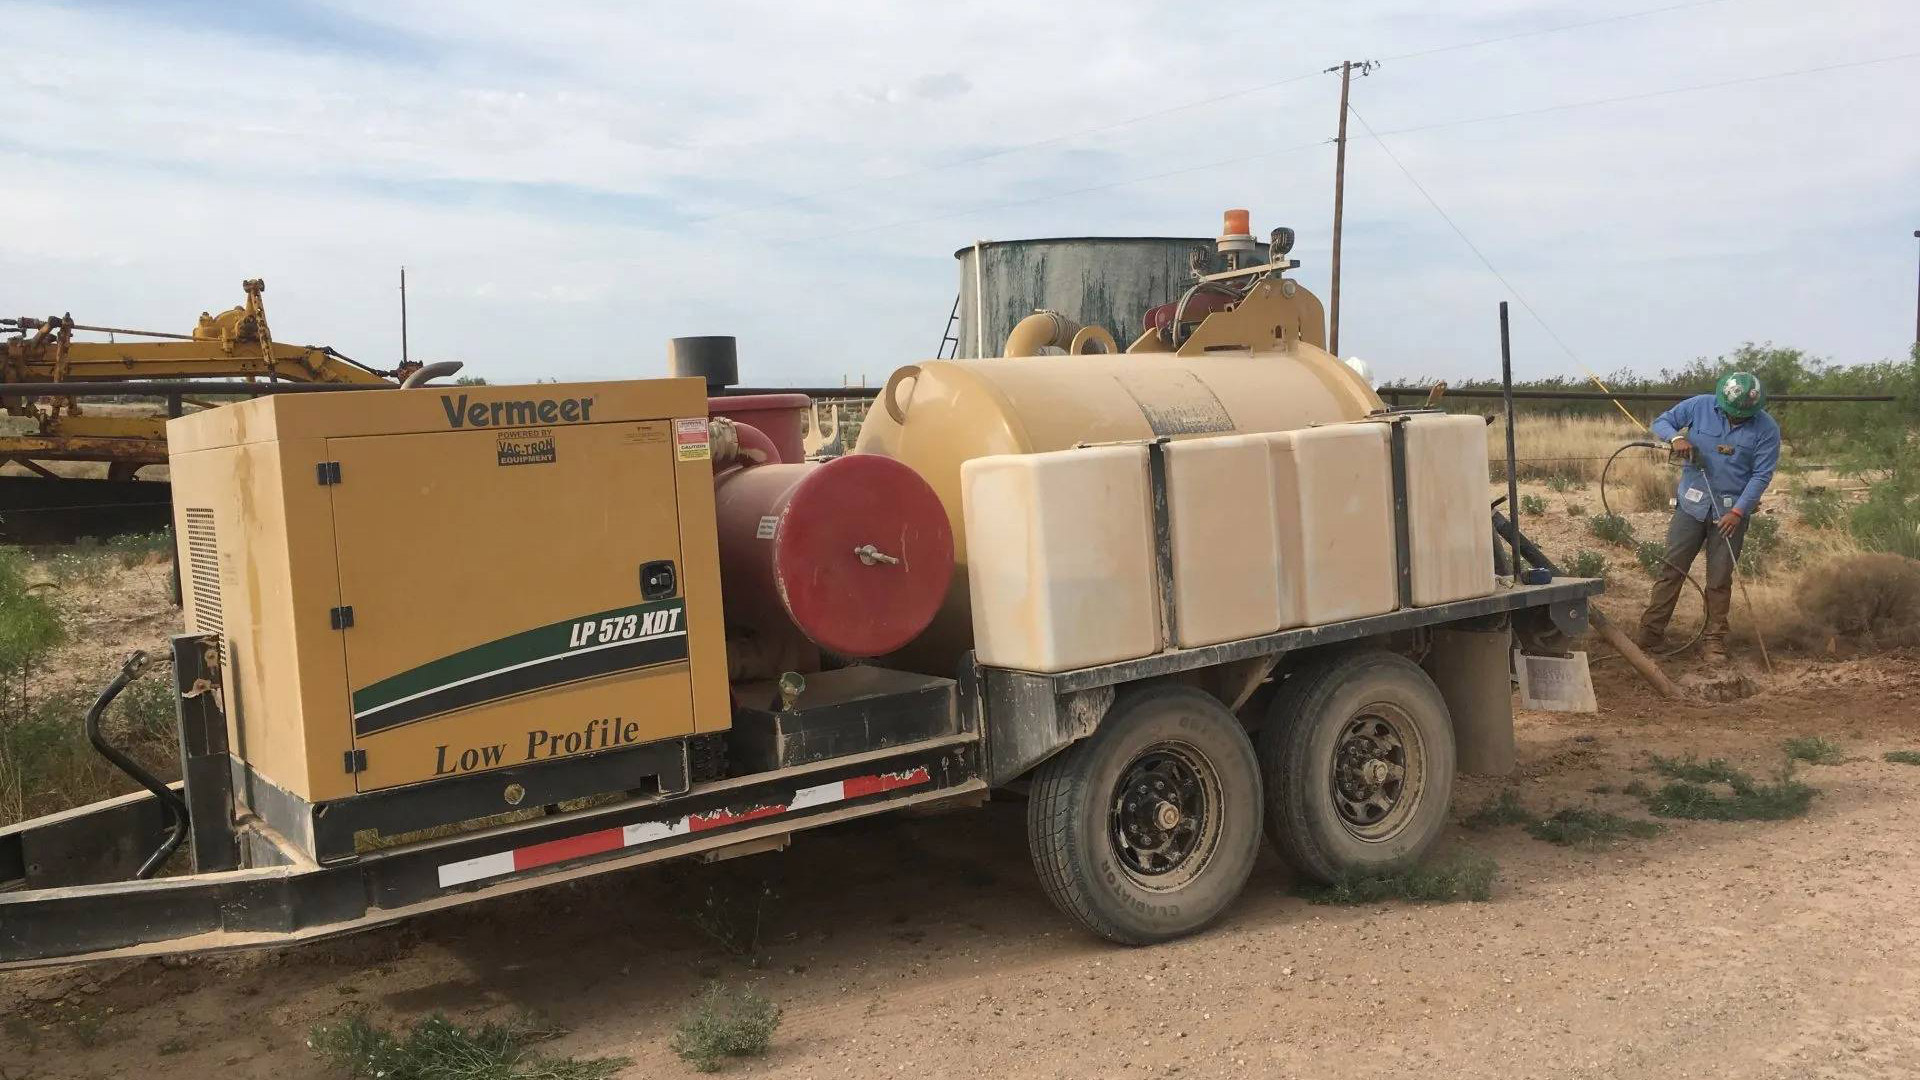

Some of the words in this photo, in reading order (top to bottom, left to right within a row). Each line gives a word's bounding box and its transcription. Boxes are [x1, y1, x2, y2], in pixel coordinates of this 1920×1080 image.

[440, 394, 594, 428] Vermeer
[498, 430, 540, 439] POWERED
[501, 454, 552, 464] EQUIPMENT
[569, 621, 596, 648] LP
[598, 614, 638, 643] 573
[639, 607, 682, 636] XDT
[433, 743, 508, 776] Low
[524, 717, 640, 760] Profile
